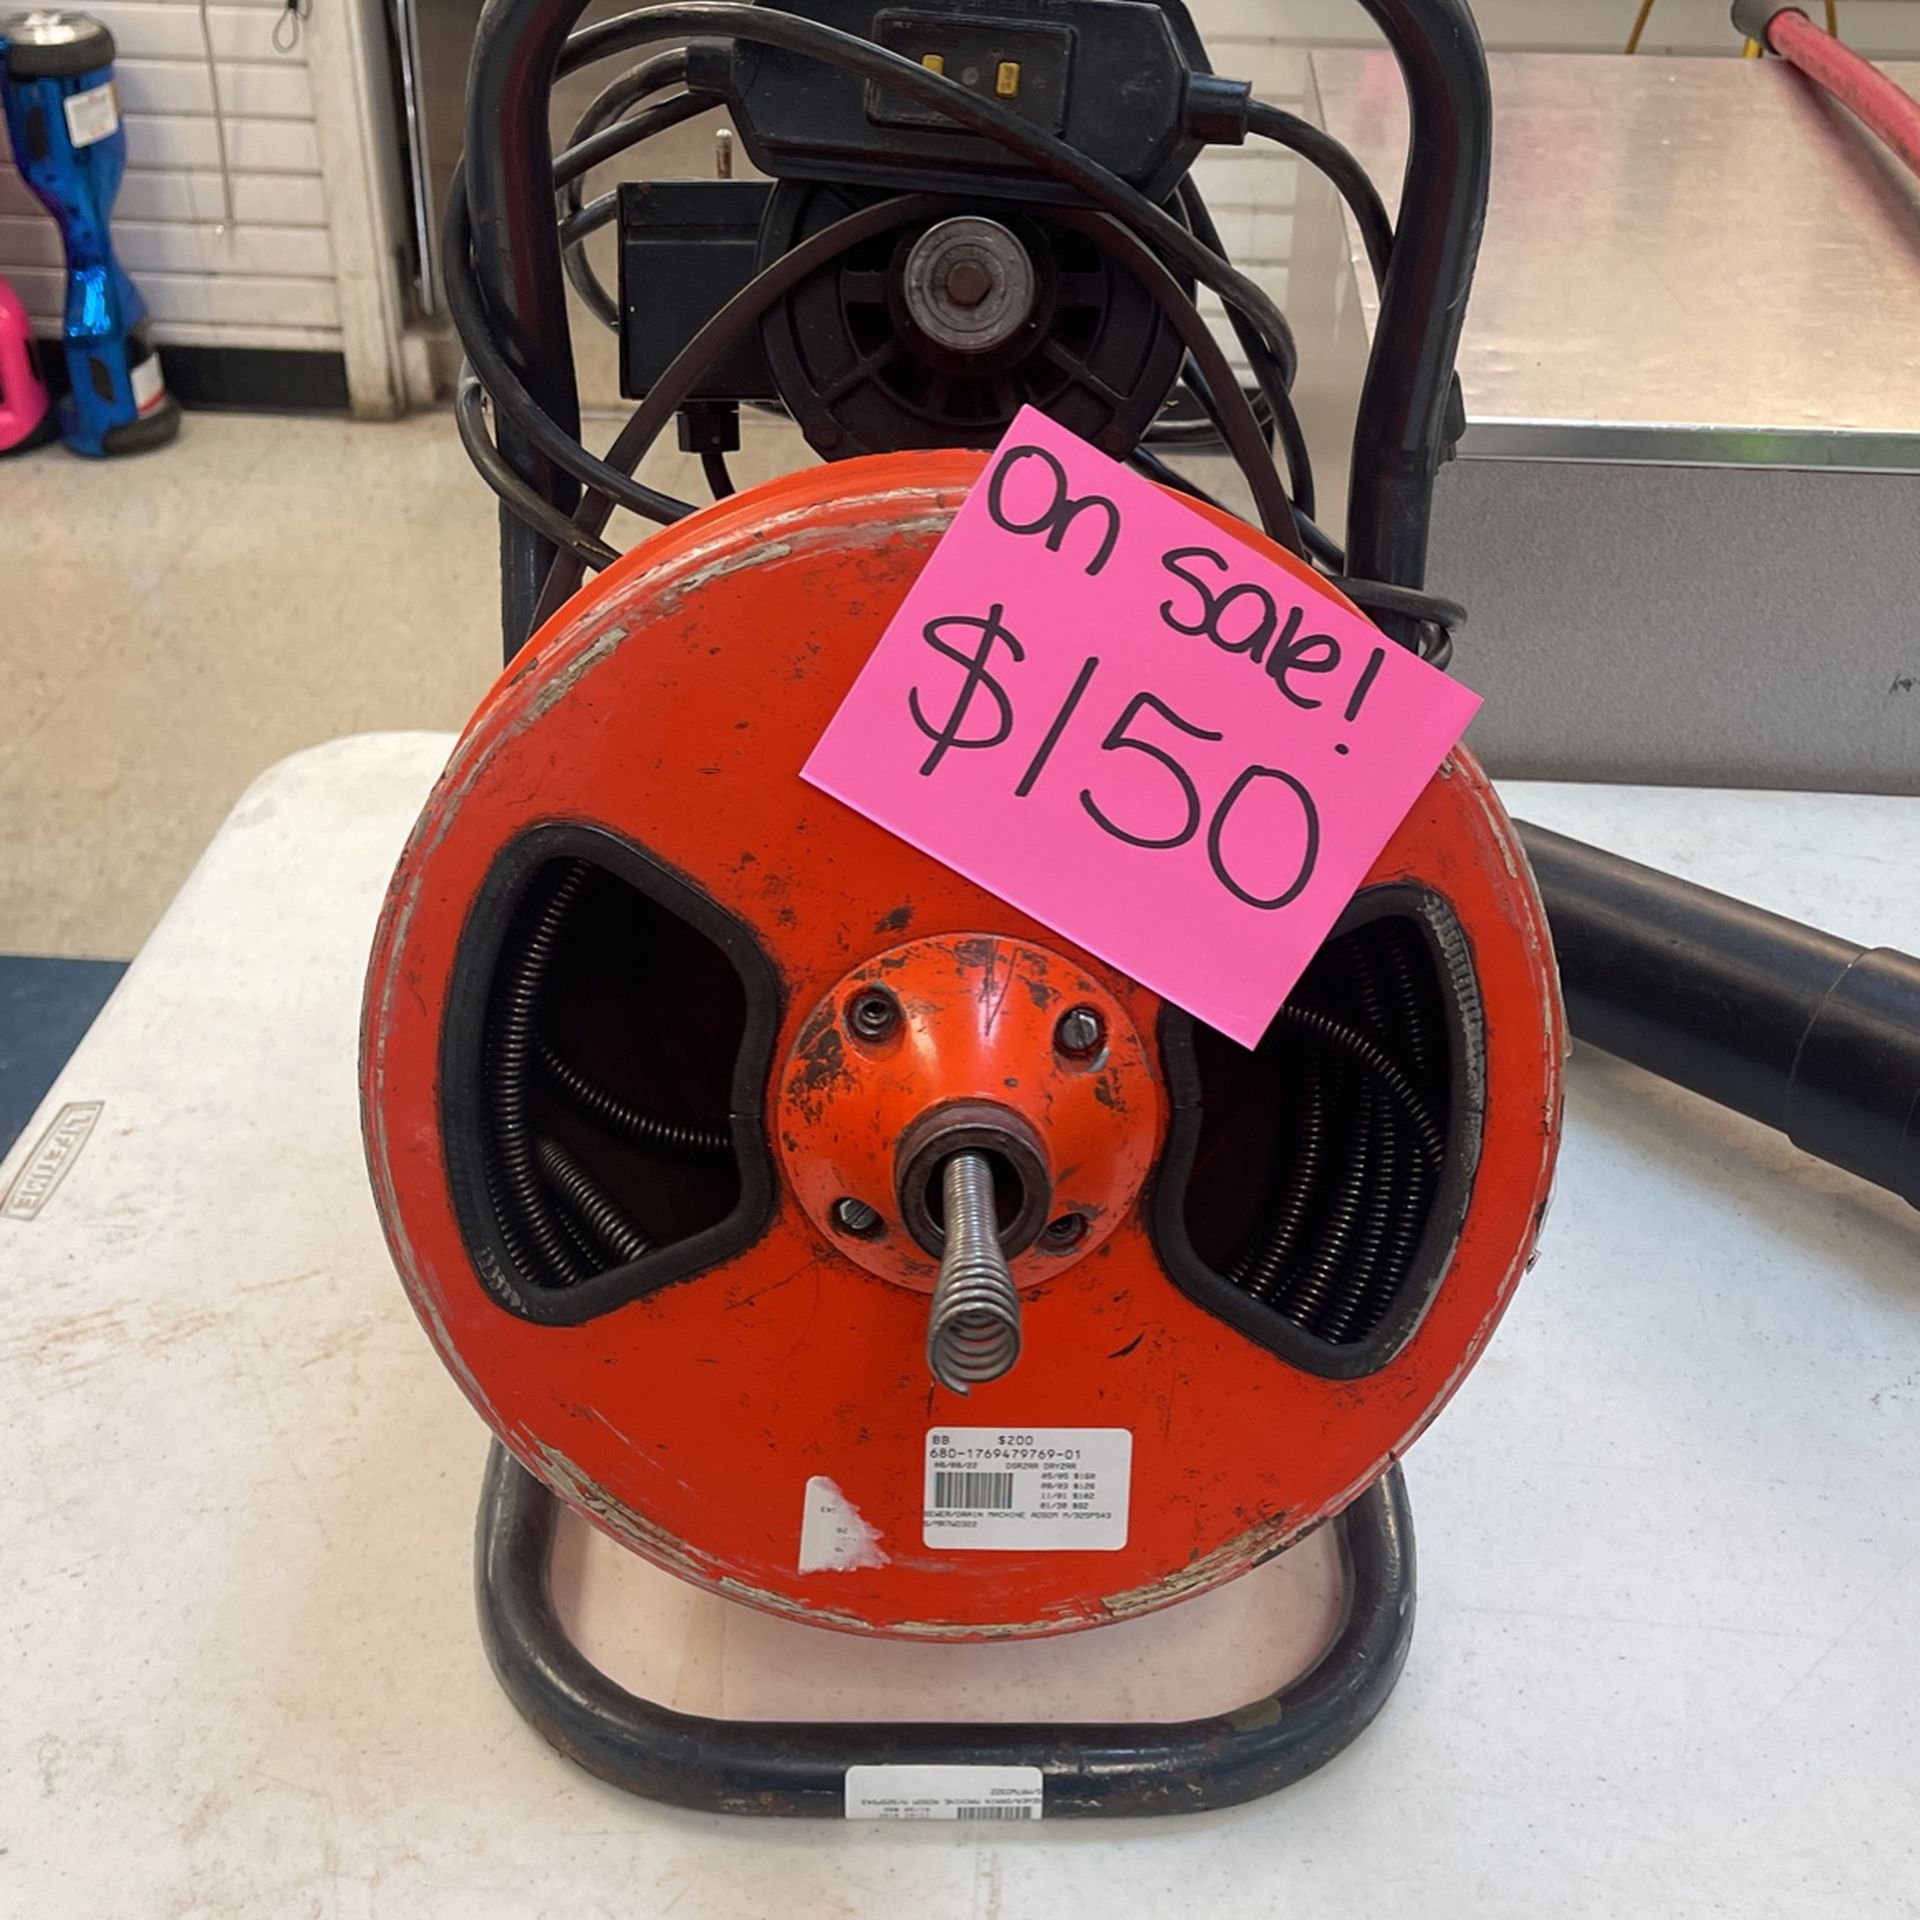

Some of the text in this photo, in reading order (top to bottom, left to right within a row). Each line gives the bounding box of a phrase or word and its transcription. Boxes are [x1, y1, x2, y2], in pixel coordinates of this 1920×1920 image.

[987, 444, 1386, 756] On sale!
[907, 602, 1321, 911] $150
[12, 1107, 98, 1211] LIFETIME
[929, 1447, 1081, 1461] 680-1769479769-01
[932, 1434, 1034, 1446] BB $200
[987, 1511, 1025, 1519] MACHINE
